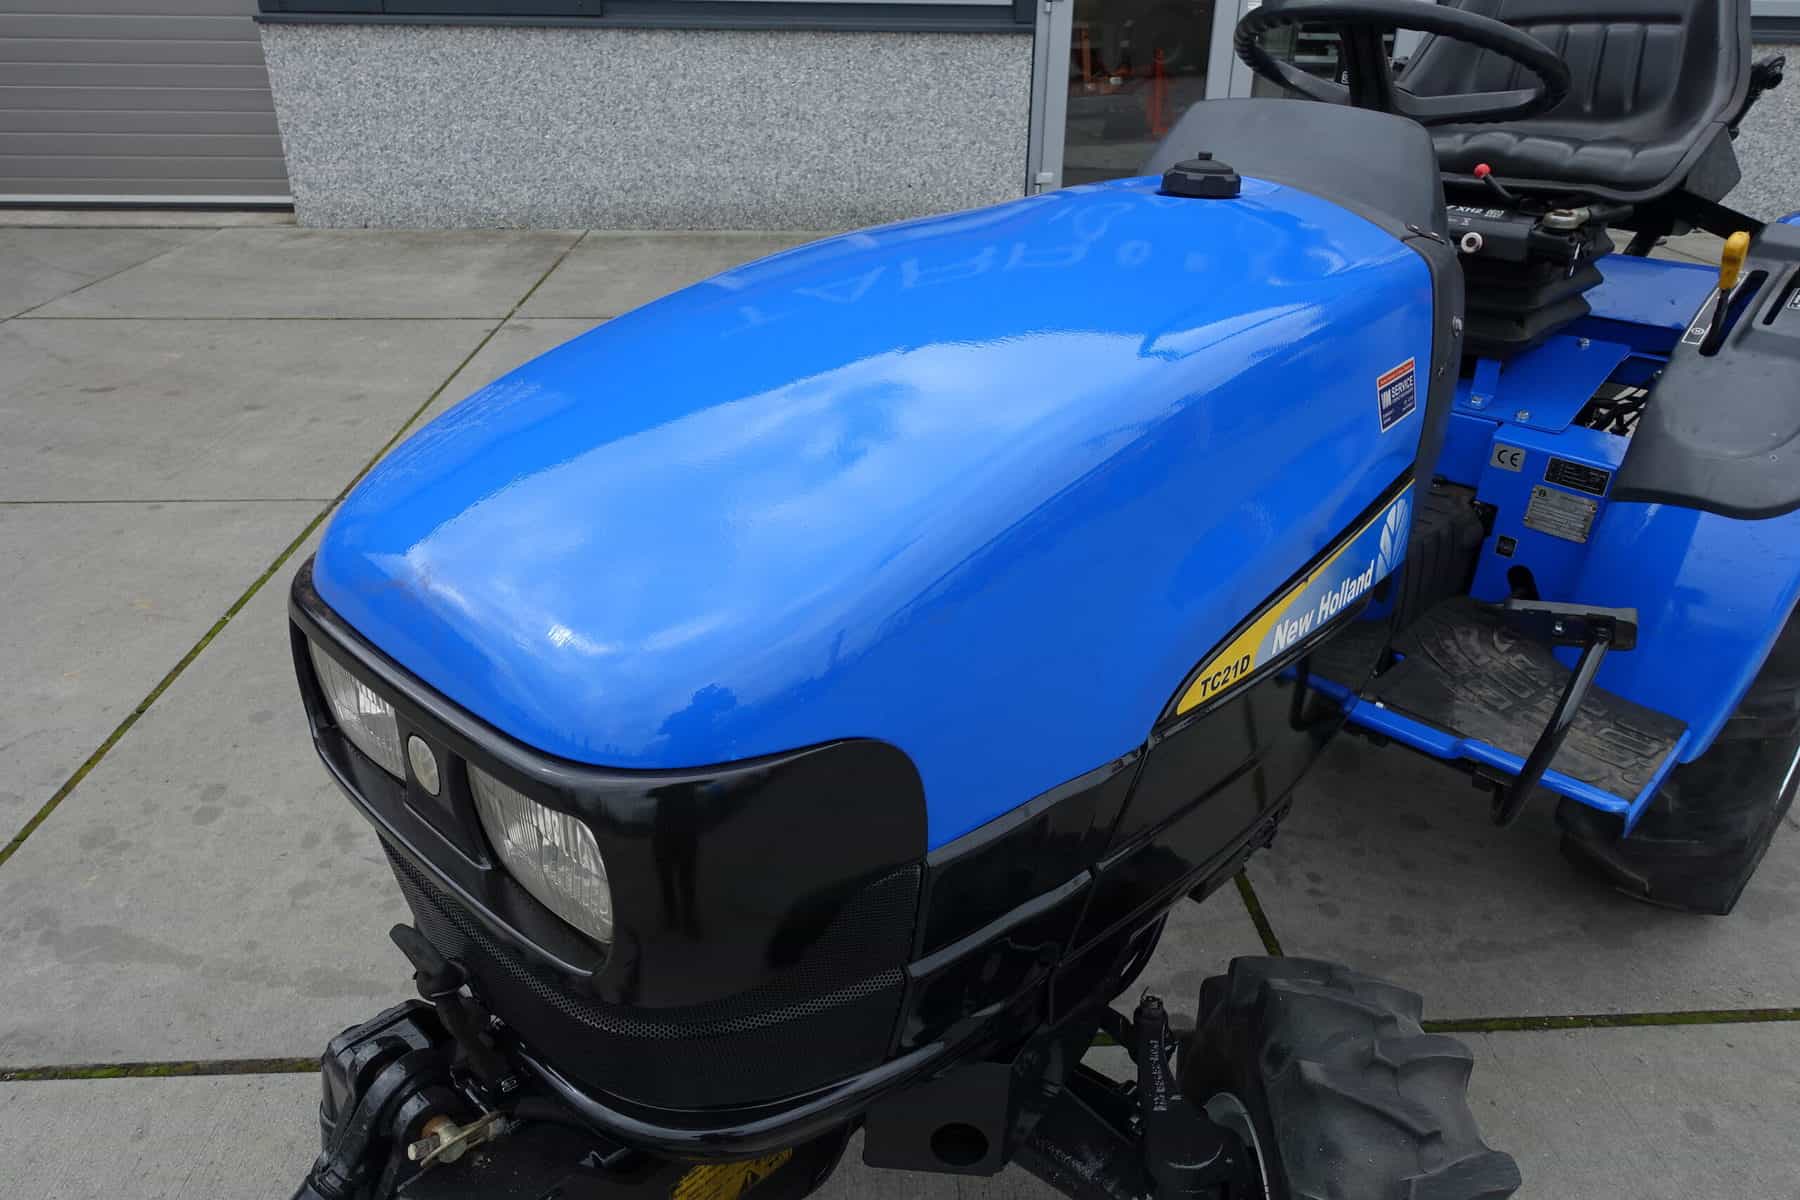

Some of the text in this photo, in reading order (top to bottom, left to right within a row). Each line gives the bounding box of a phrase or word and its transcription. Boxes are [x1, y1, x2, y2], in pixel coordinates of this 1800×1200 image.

[1391, 376, 1414, 398] SERVICE
[1497, 450, 1521, 467] CE
[1271, 560, 1375, 655] New Holland
[1201, 654, 1251, 697] TC21D
